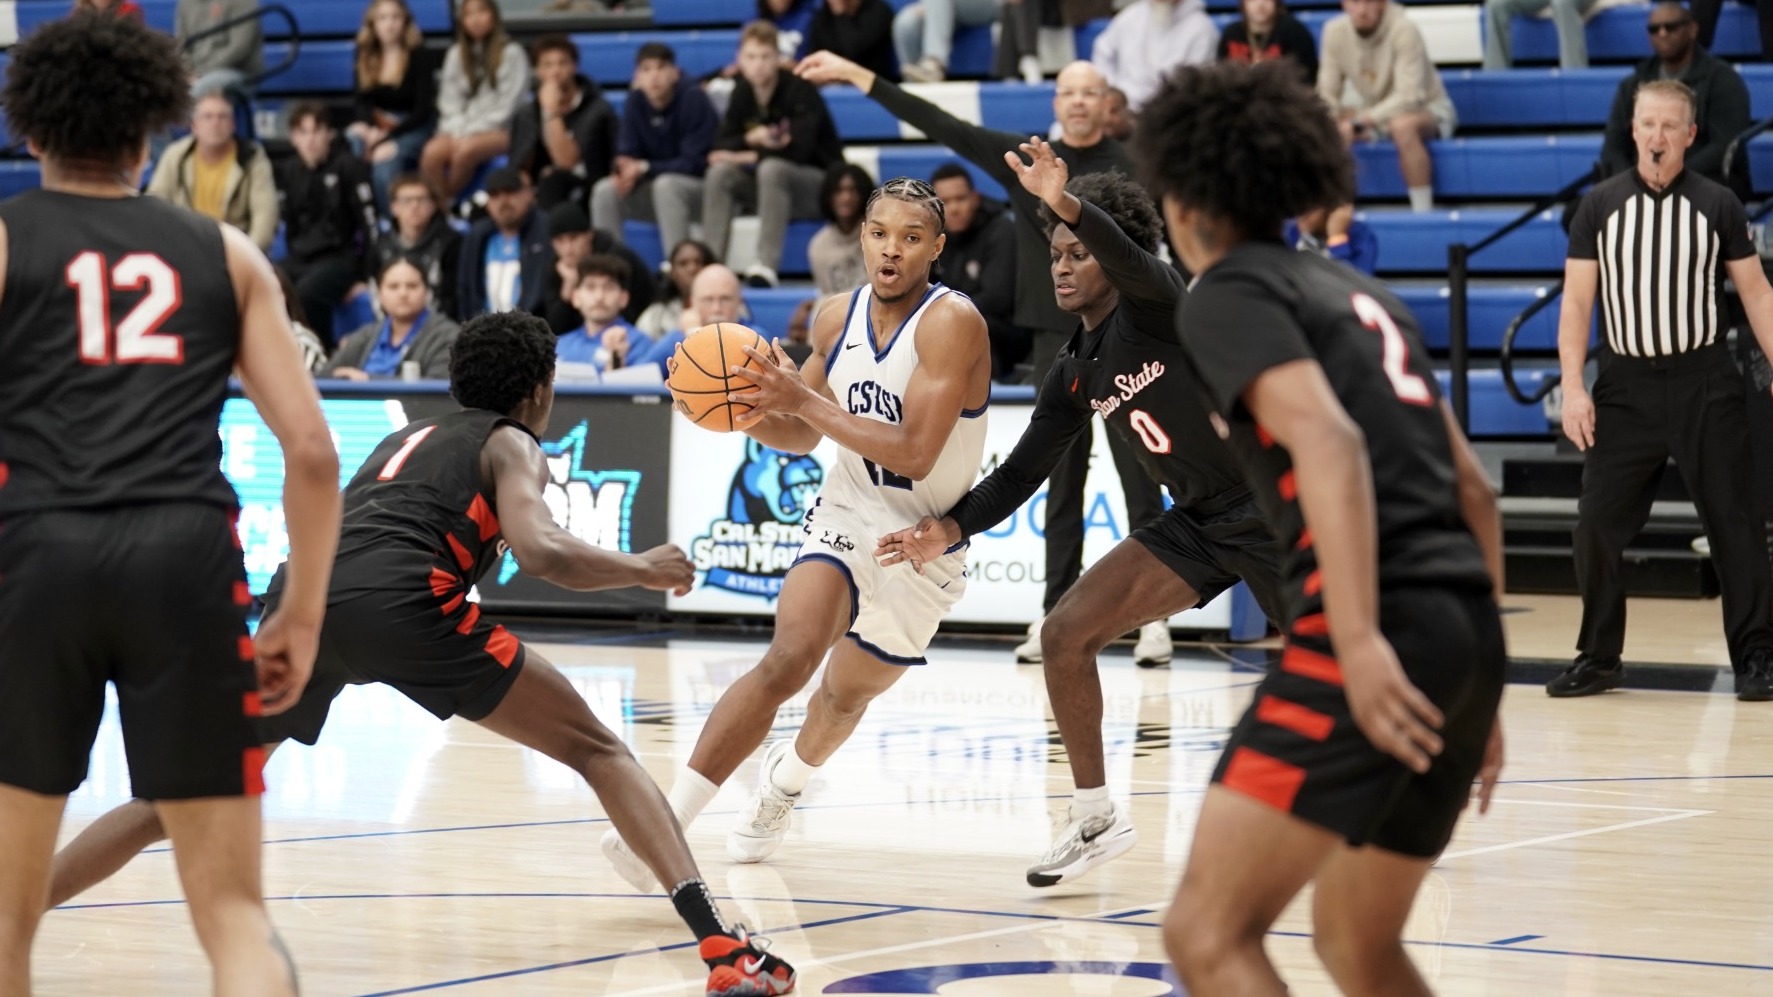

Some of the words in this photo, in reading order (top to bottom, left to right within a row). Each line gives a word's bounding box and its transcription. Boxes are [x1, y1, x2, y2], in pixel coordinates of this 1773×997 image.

[65, 249, 184, 366] 12
[1350, 290, 1434, 406] 2
[1114, 361, 1165, 401] State
[376, 423, 438, 481] 1
[1129, 408, 1172, 454] 0
[759, 520, 804, 545] STA
